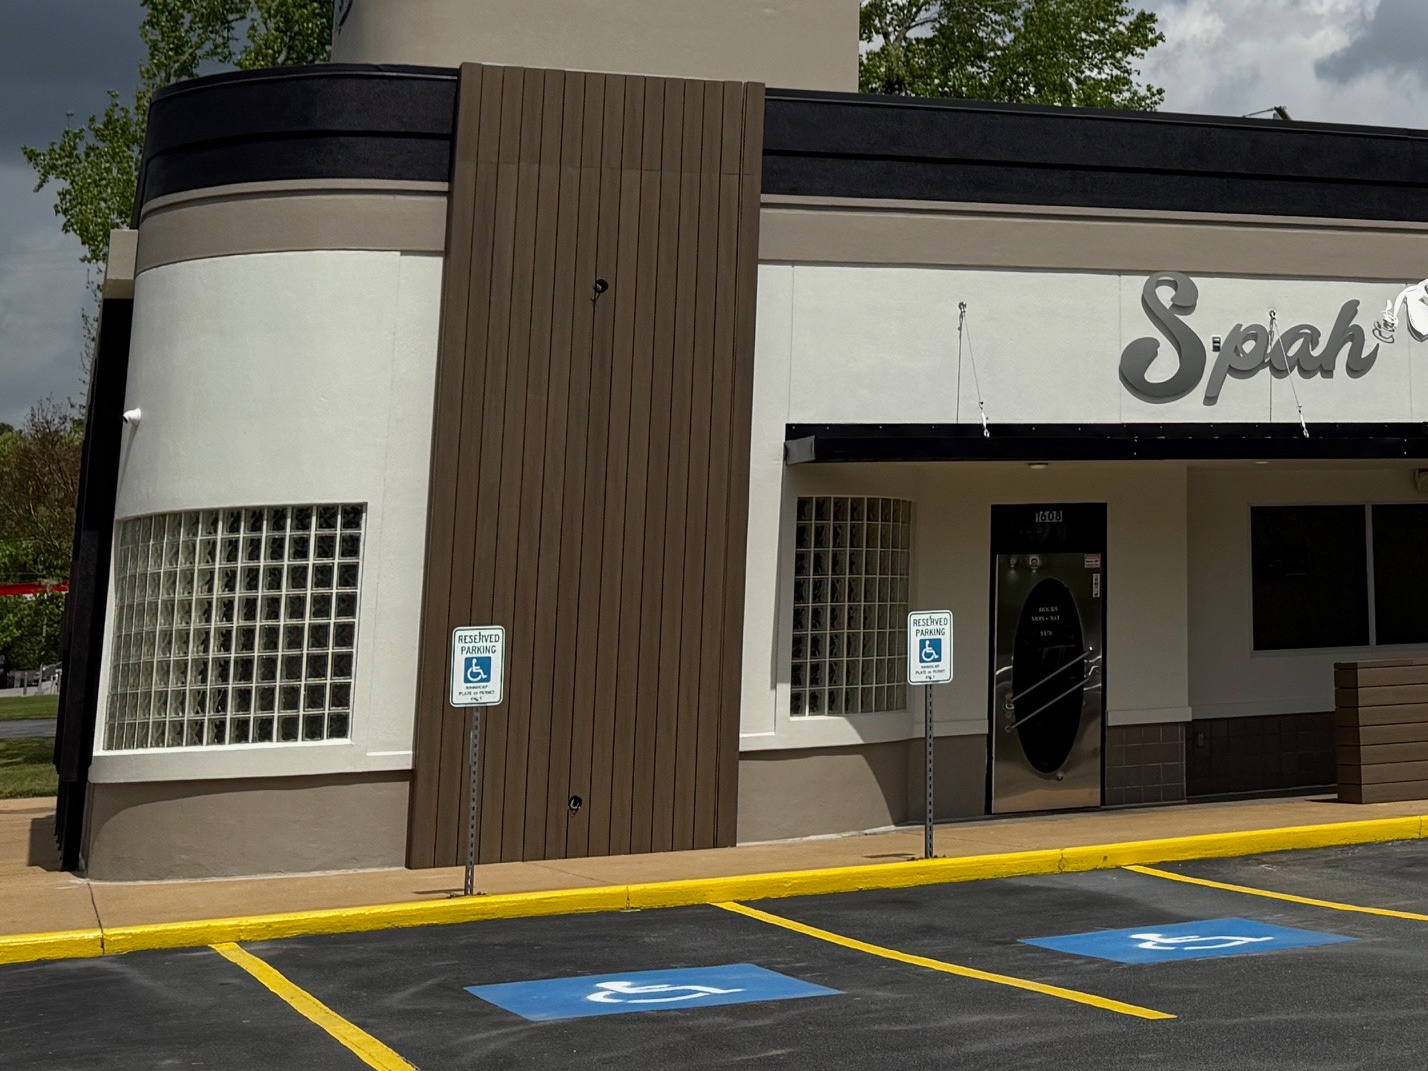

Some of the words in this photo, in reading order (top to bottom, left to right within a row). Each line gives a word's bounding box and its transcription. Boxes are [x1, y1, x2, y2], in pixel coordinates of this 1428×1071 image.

[1119, 271, 1379, 406] Spah
[1036, 510, 1063, 522] 1608
[913, 617, 948, 626] RESERVED
[915, 628, 946, 637] PARKING
[458, 633, 500, 644] RESERVED
[461, 645, 497, 655] PARKING
